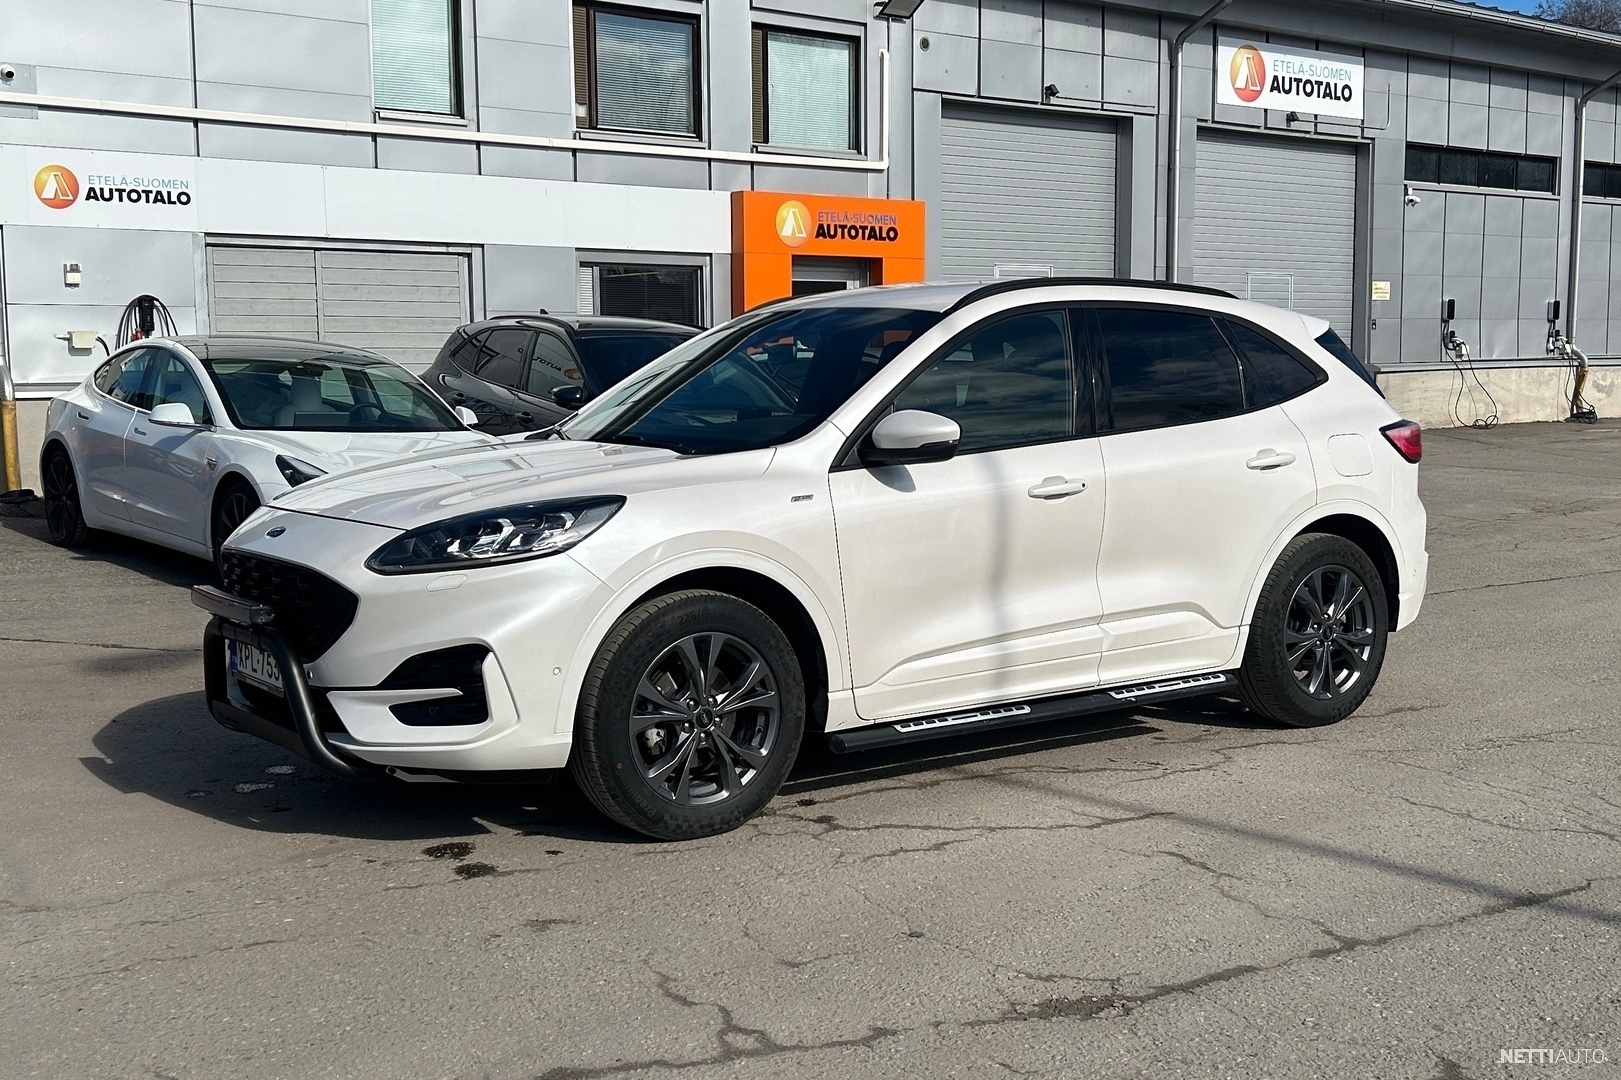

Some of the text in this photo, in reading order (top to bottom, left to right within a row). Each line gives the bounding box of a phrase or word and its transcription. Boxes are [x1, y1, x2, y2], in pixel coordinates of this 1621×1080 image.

[1273, 59, 1352, 82] ETELÄ-SUOMEN
[1269, 75, 1353, 102] AUTOTALO
[88, 174, 189, 190] ETELÄ-SUOMEN
[85, 187, 191, 206] AUTOTALO
[817, 210, 897, 225] ETELÄ-SUOMEN
[815, 223, 898, 242] AUTOTALO
